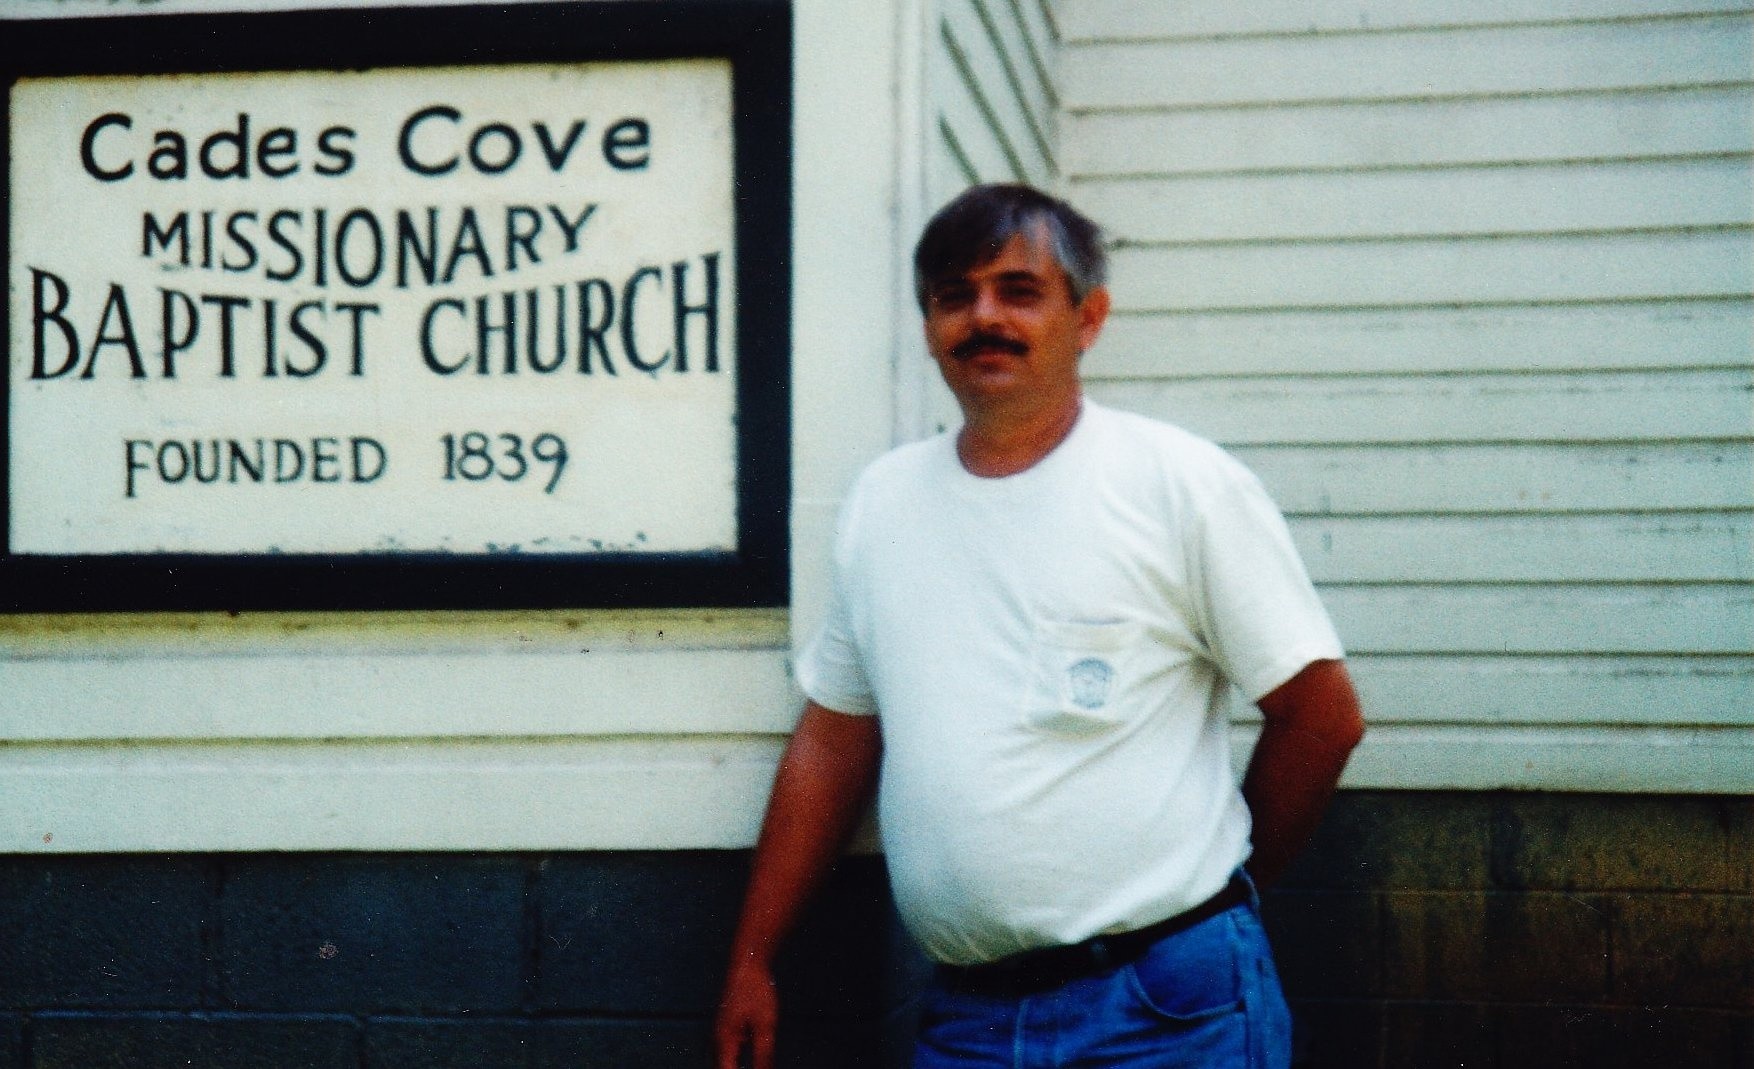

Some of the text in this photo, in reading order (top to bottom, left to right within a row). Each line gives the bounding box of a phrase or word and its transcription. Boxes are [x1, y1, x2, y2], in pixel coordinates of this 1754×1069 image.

[79, 104, 652, 183] Cades Cove
[140, 203, 598, 289] MISSIONARY
[28, 251, 722, 381] BAPTIST CHURCH
[123, 431, 570, 499] FOUNDED 1839
